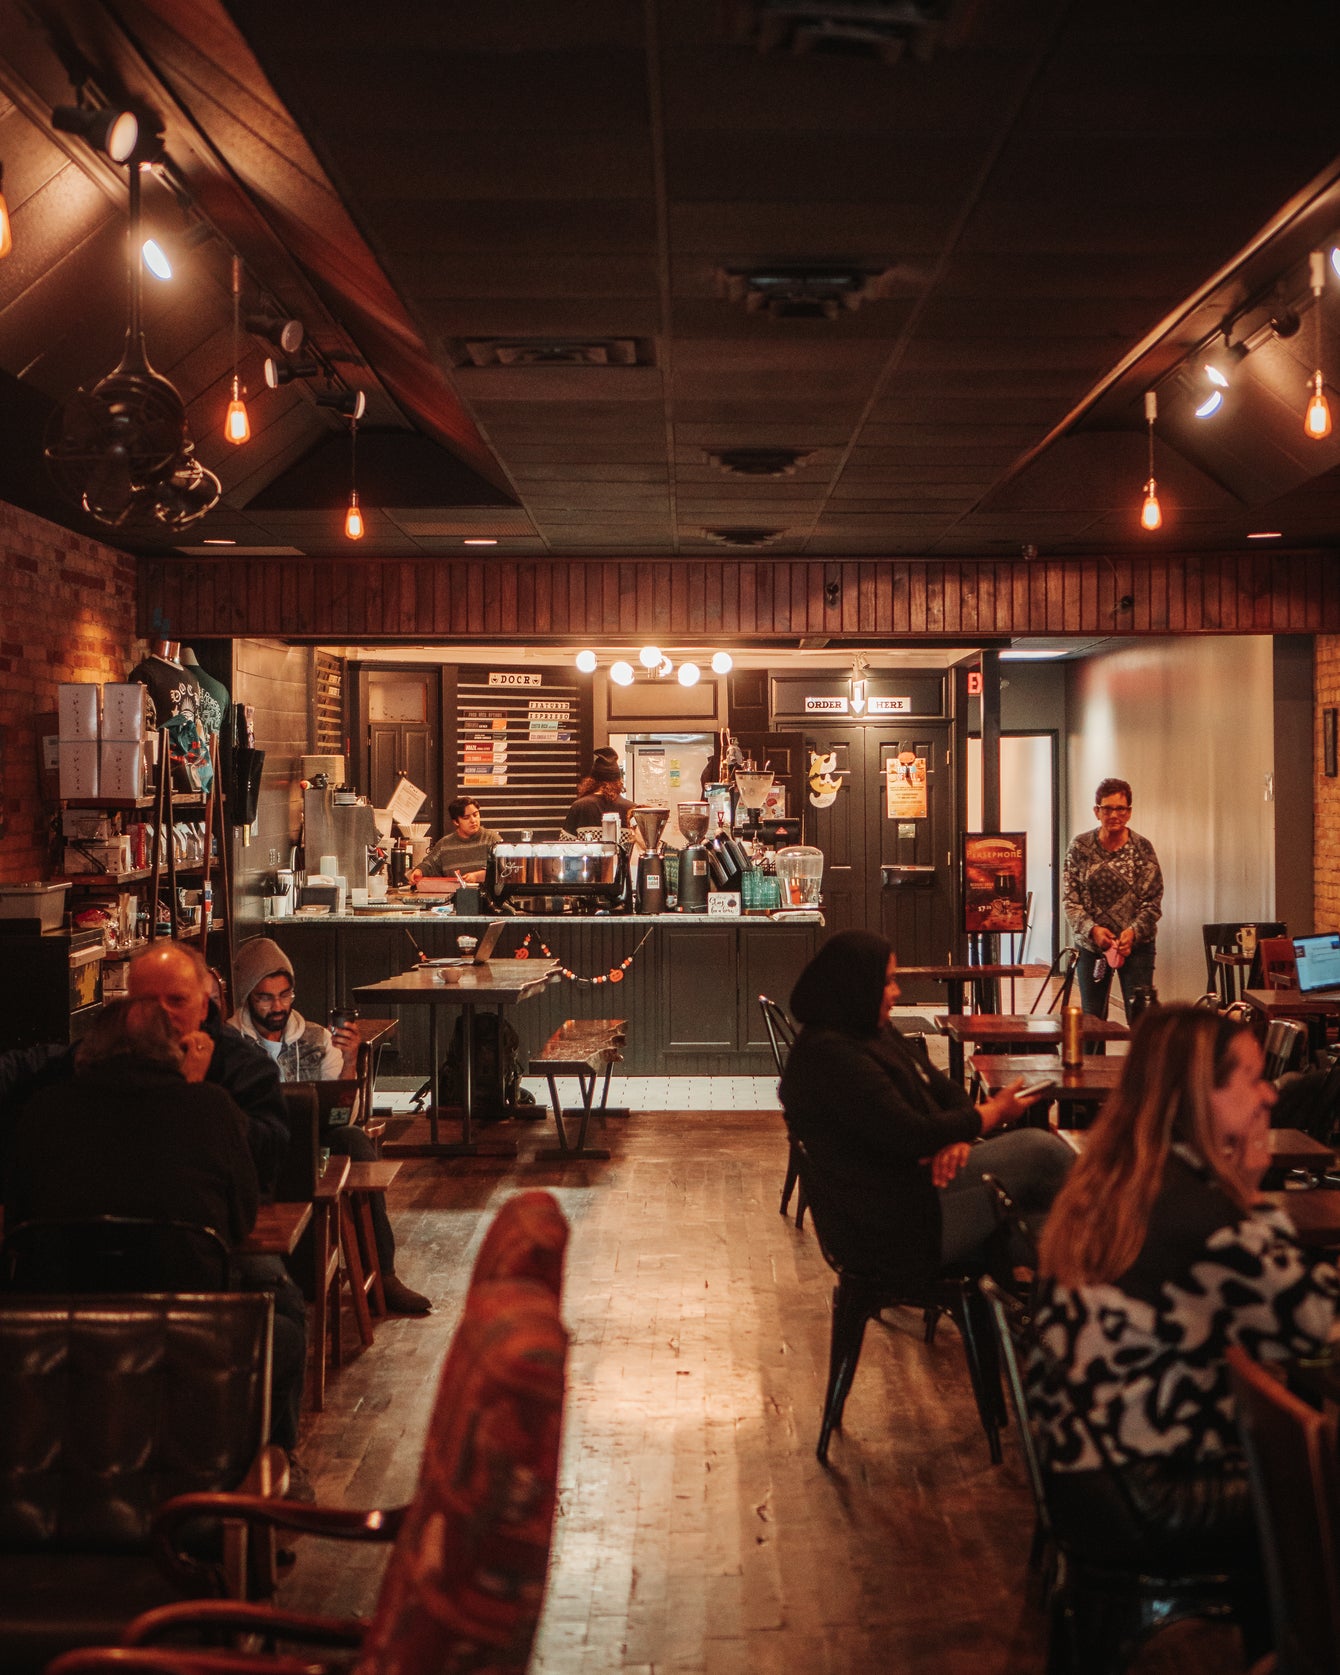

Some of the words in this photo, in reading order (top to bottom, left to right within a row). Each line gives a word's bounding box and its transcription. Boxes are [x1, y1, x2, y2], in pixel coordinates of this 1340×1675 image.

[500, 675, 530, 685] DOCR
[807, 701, 842, 709] ORDER
[876, 701, 904, 709] HERE
